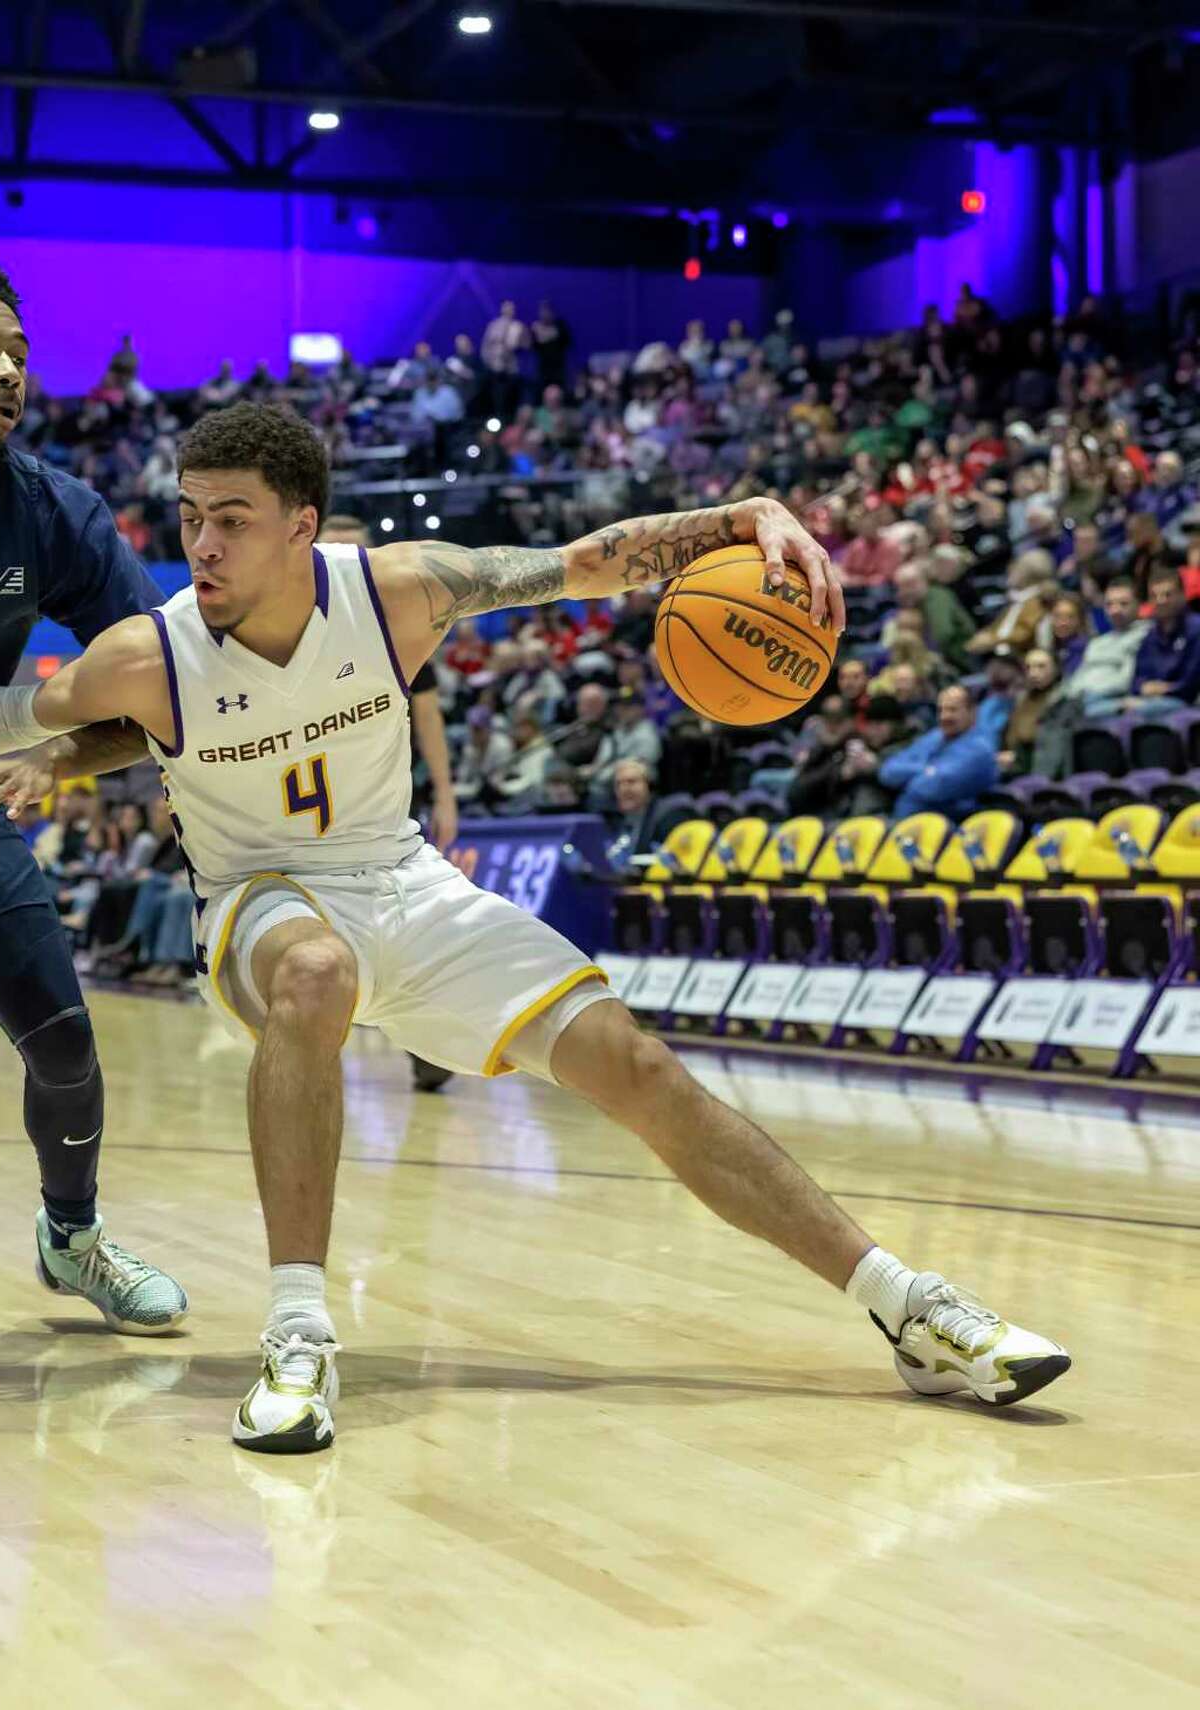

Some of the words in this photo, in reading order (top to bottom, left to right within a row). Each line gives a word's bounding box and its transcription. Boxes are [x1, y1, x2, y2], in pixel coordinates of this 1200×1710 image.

[723, 612, 820, 690] Wilson
[198, 731, 292, 764] GREAT
[304, 693, 391, 743] DANES
[280, 751, 334, 839] 4
